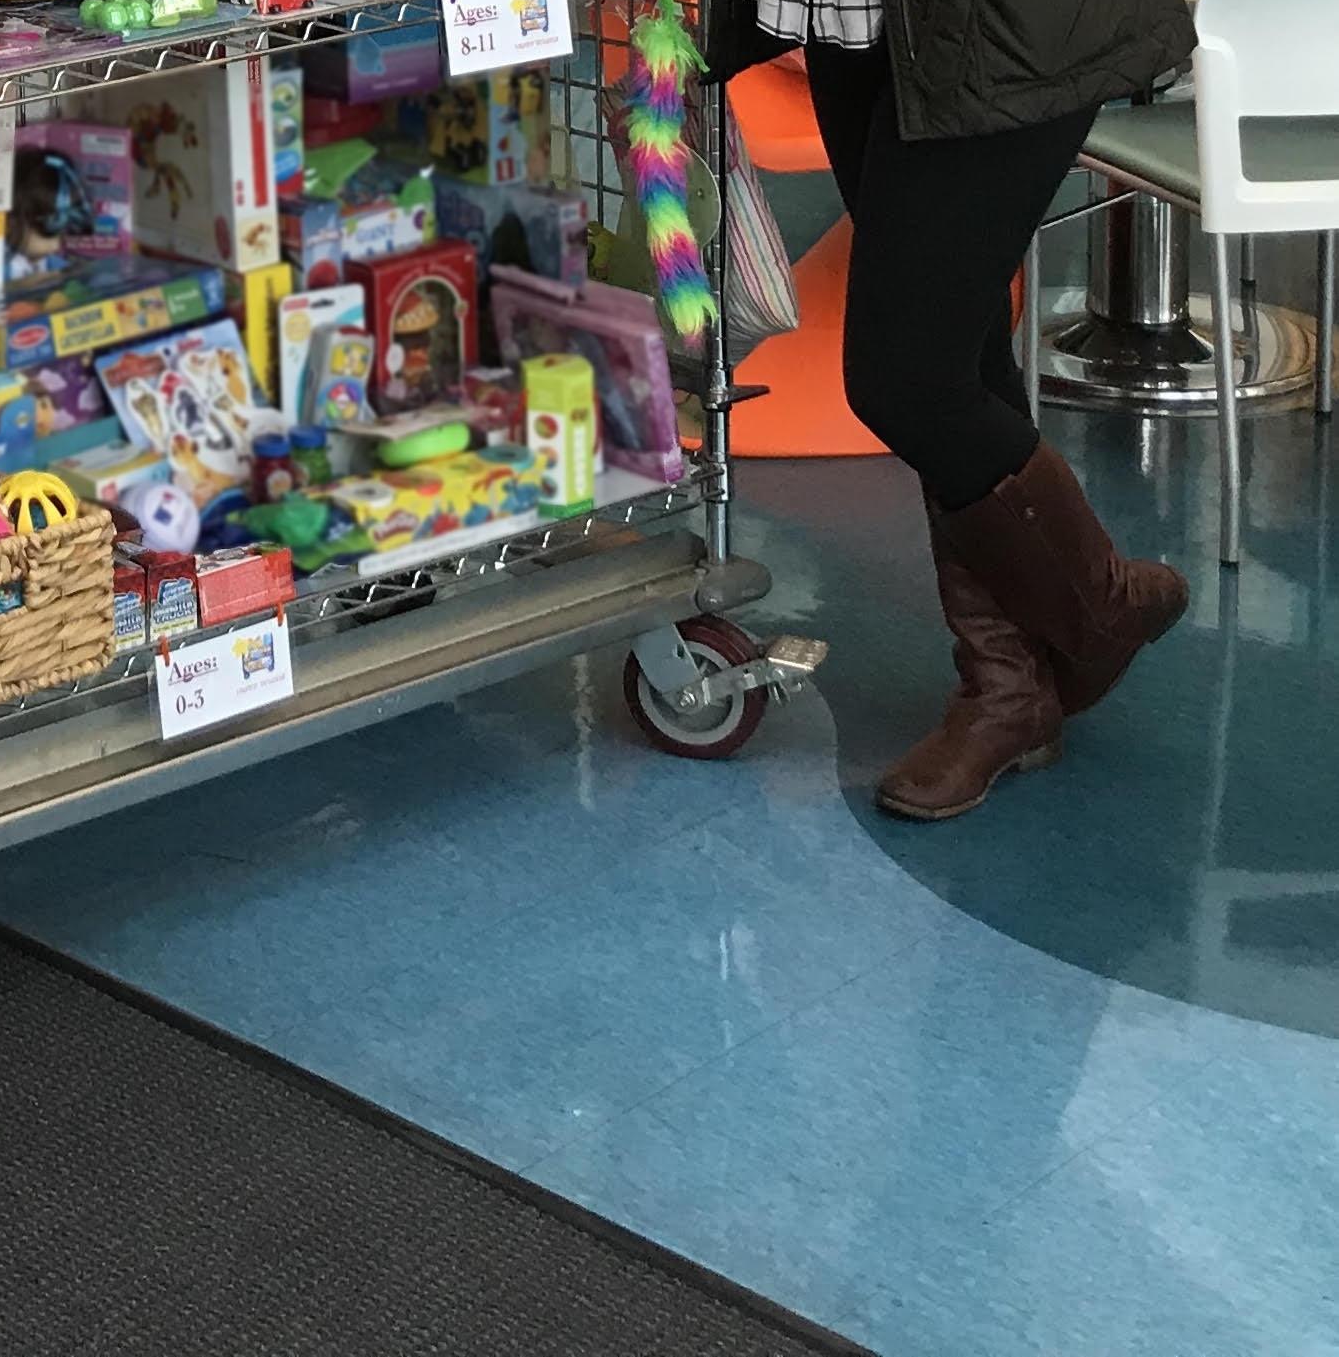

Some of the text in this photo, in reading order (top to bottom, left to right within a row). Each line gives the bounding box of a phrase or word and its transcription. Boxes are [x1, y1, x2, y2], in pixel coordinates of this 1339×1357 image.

[454, 4, 498, 26] Ages:
[461, 32, 495, 56] 8-11
[168, 655, 218, 682] Ages:
[176, 688, 205, 714] 0-3
